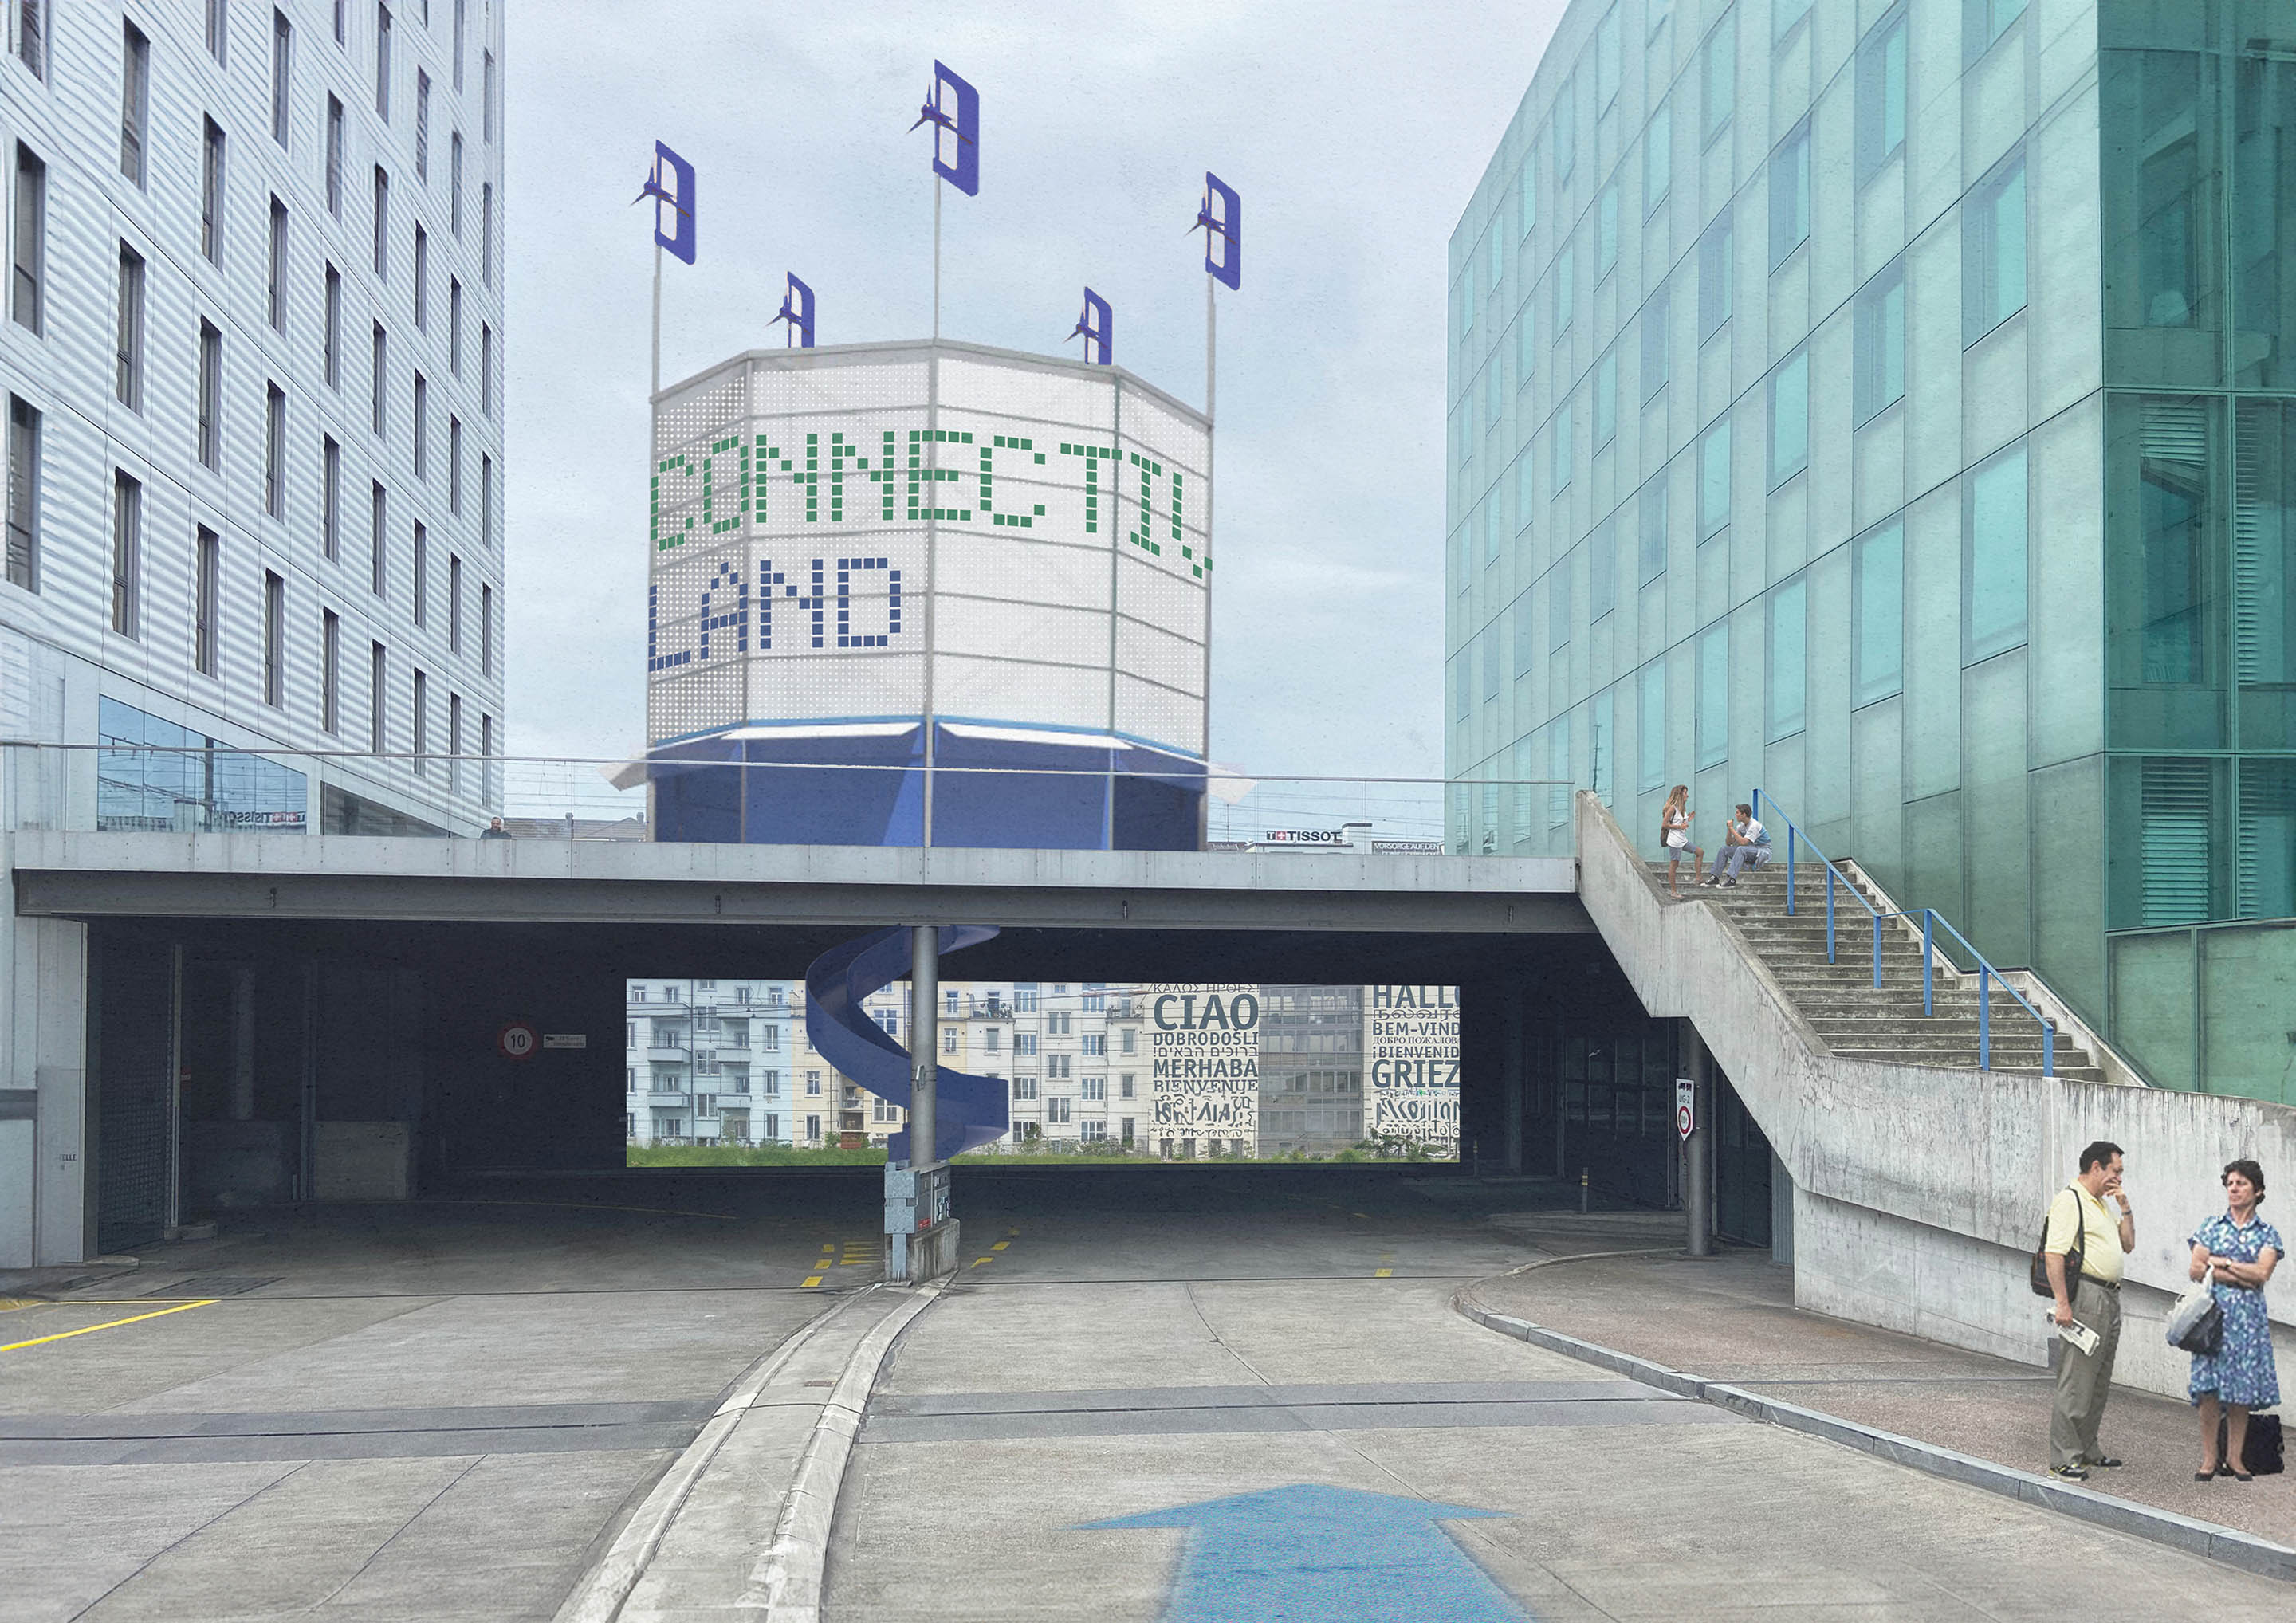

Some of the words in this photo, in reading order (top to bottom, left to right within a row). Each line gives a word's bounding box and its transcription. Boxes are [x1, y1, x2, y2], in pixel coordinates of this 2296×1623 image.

[649, 557, 901, 671] LAND
[1287, 831, 1342, 842] TISSOT
[1154, 993, 1259, 1030] CIAO
[510, 1034, 526, 1048] 10
[1154, 1028, 1259, 1046] DOBRODOŠLI
[1408, 1036, 1460, 1045] ПОЖАЛОВ
[1154, 1059, 1259, 1078] MERHABA
